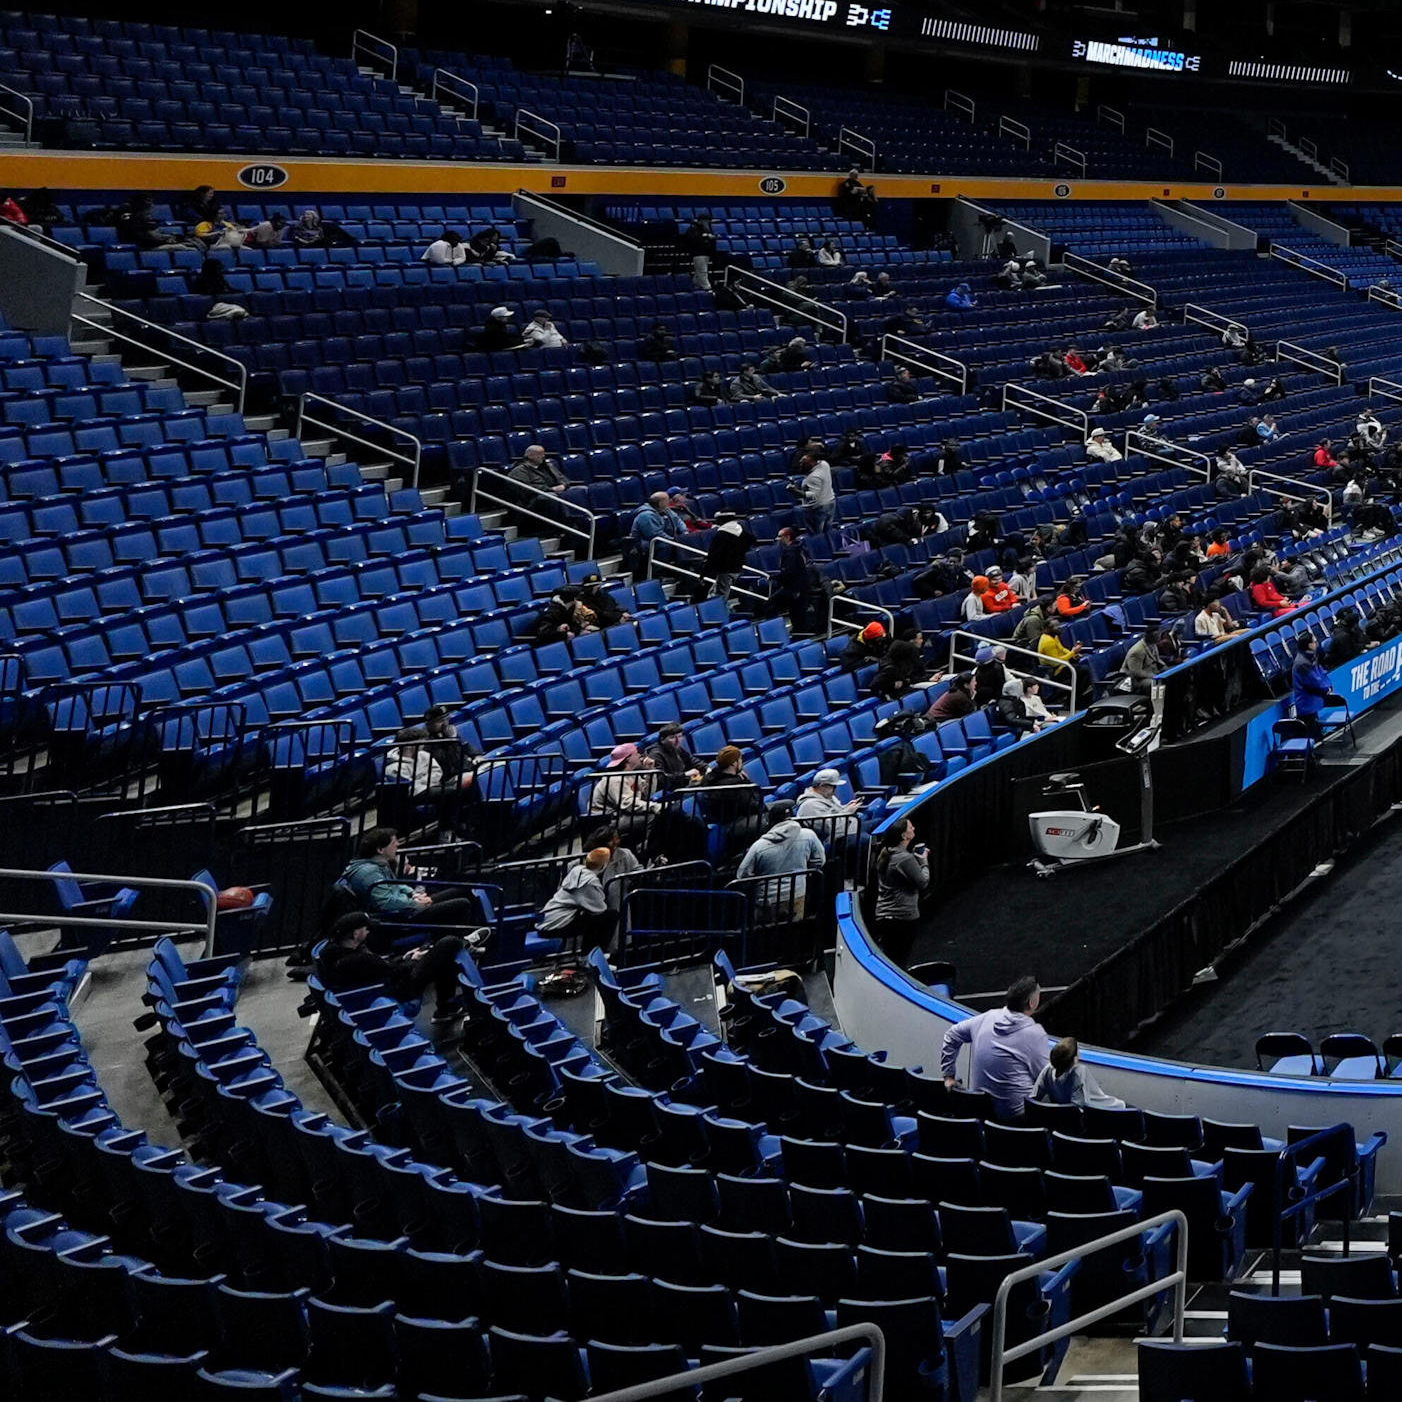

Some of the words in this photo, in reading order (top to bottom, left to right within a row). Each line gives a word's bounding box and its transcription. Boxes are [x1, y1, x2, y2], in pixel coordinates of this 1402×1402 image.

[251, 168, 274, 184] 104
[1351, 660, 1370, 692] THE
[1370, 646, 1396, 682] ROAD
